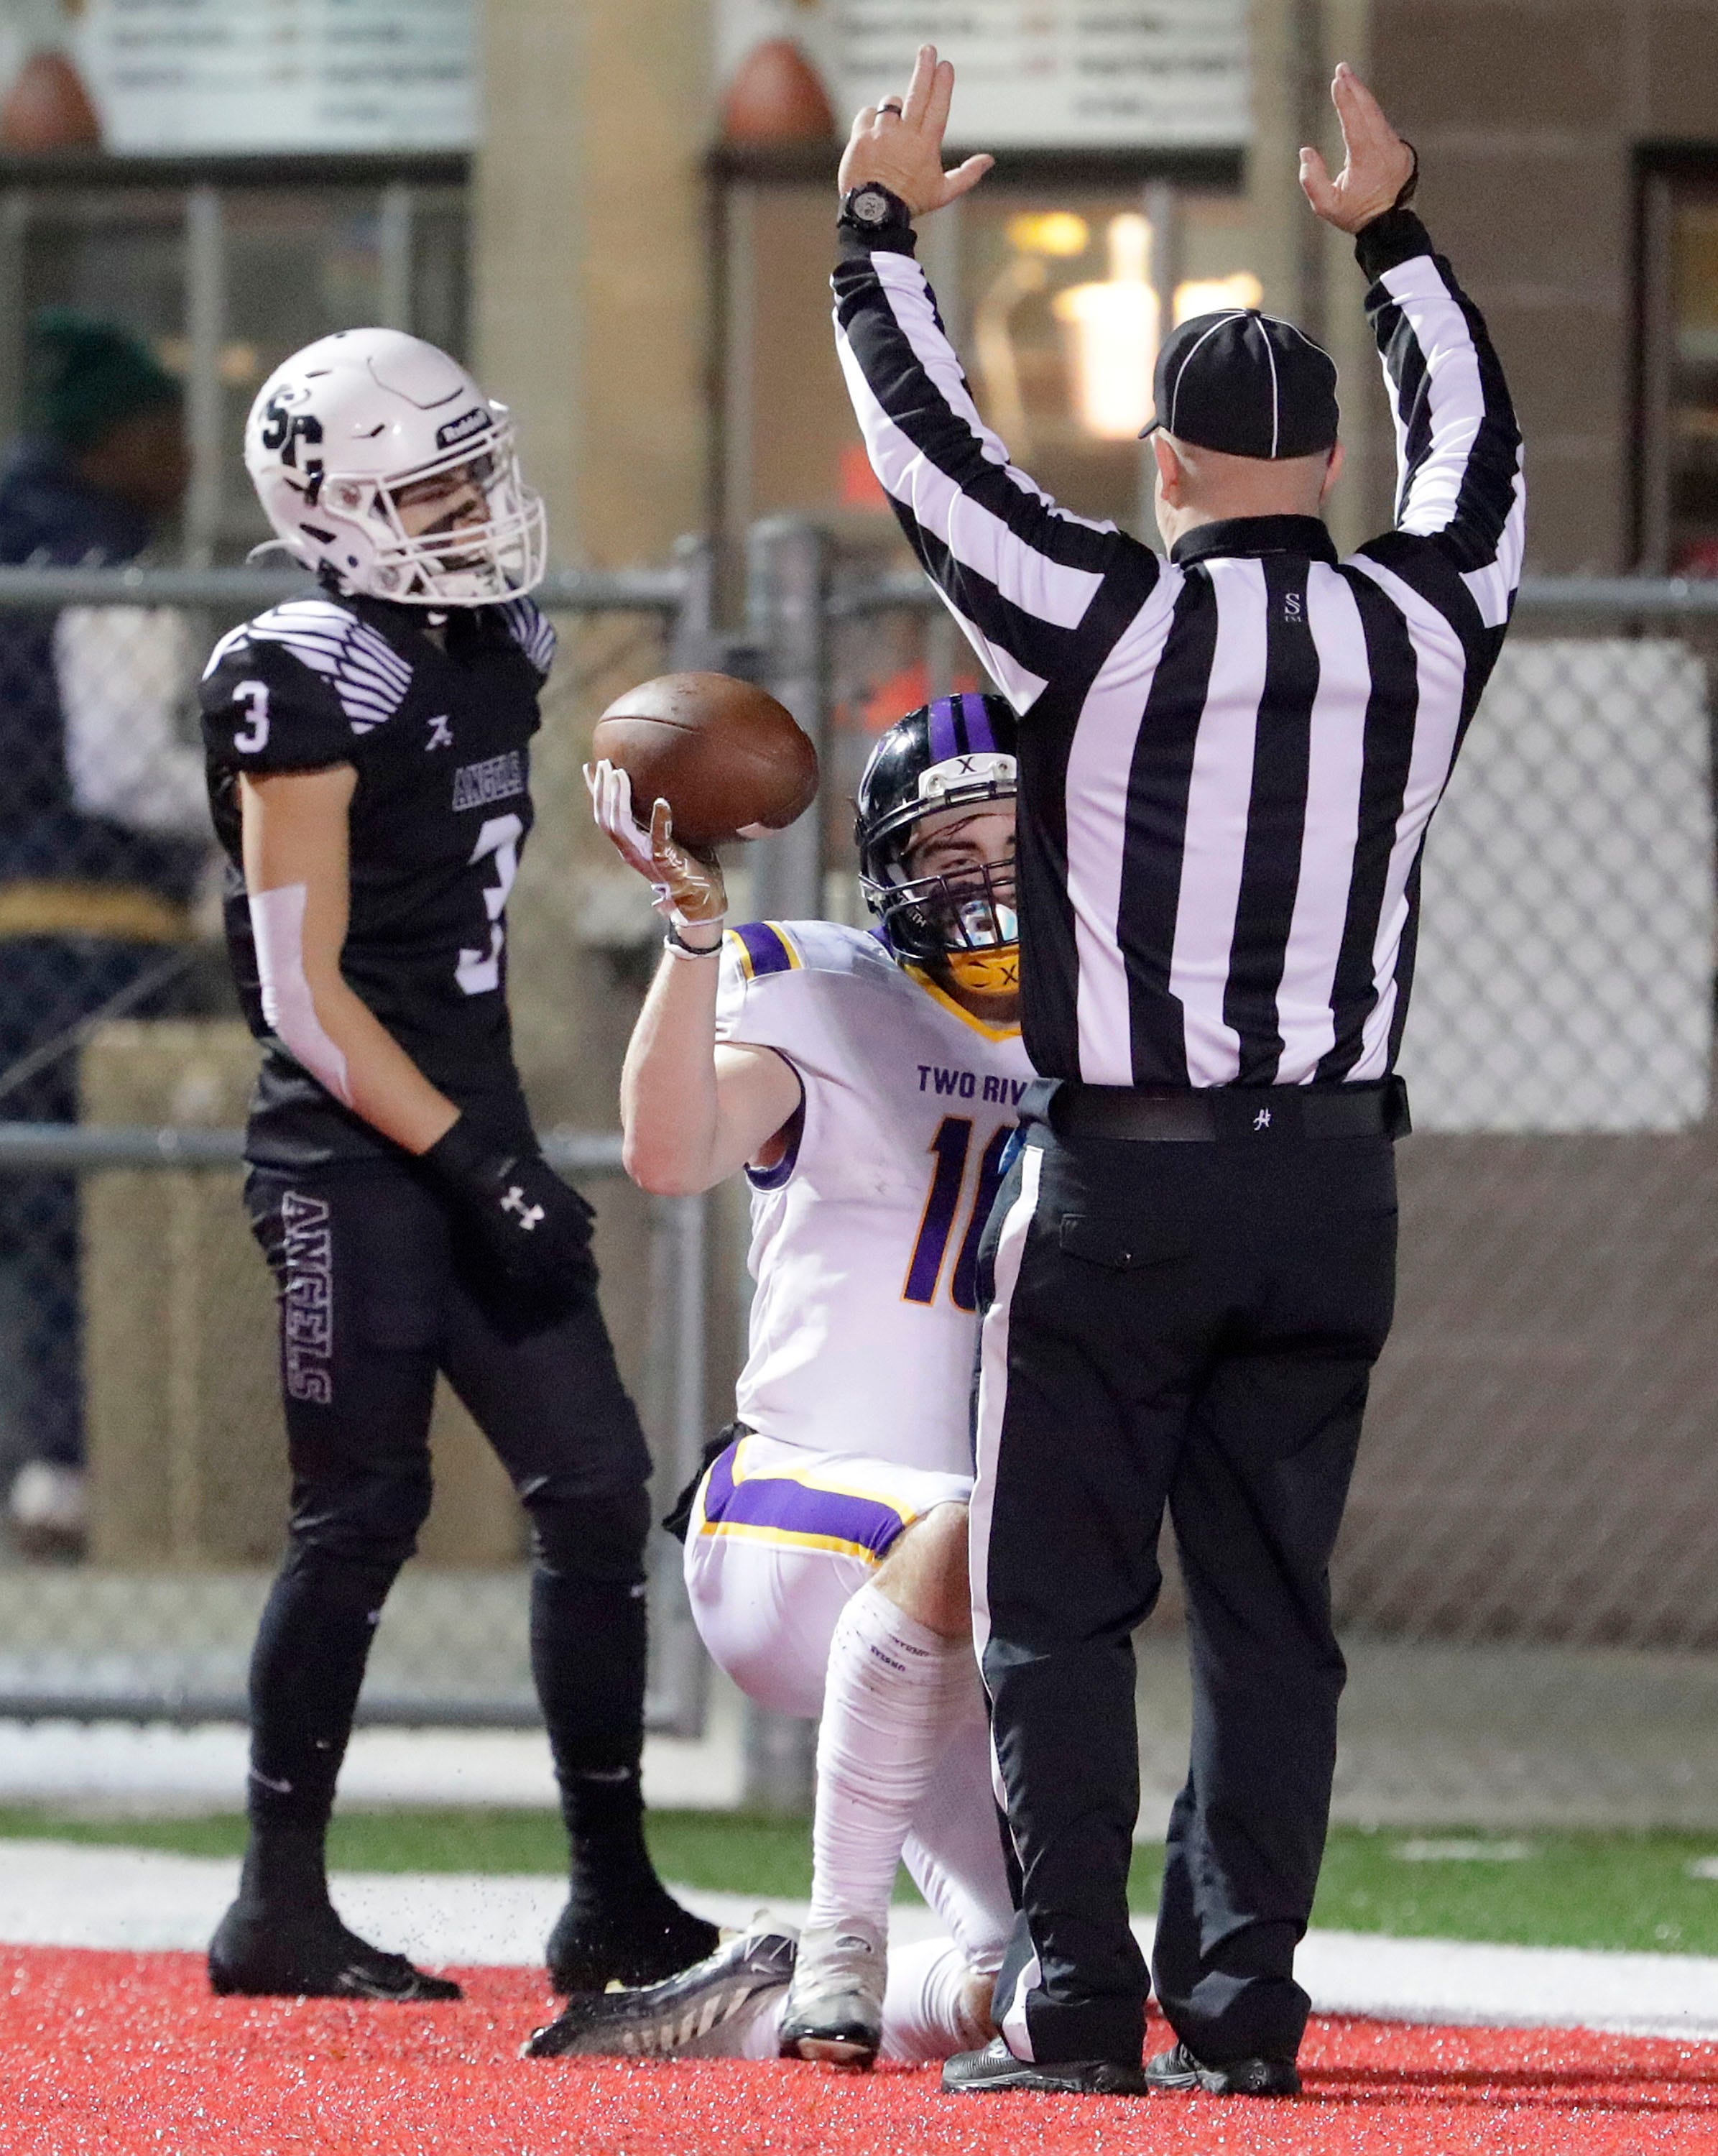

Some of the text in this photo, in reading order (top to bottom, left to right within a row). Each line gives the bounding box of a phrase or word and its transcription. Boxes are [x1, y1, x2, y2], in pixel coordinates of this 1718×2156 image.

[233, 680, 270, 755] 3
[454, 813, 524, 996] 3
[918, 1064, 976, 1099] TWO
[281, 1189, 333, 1404] ANGELS
